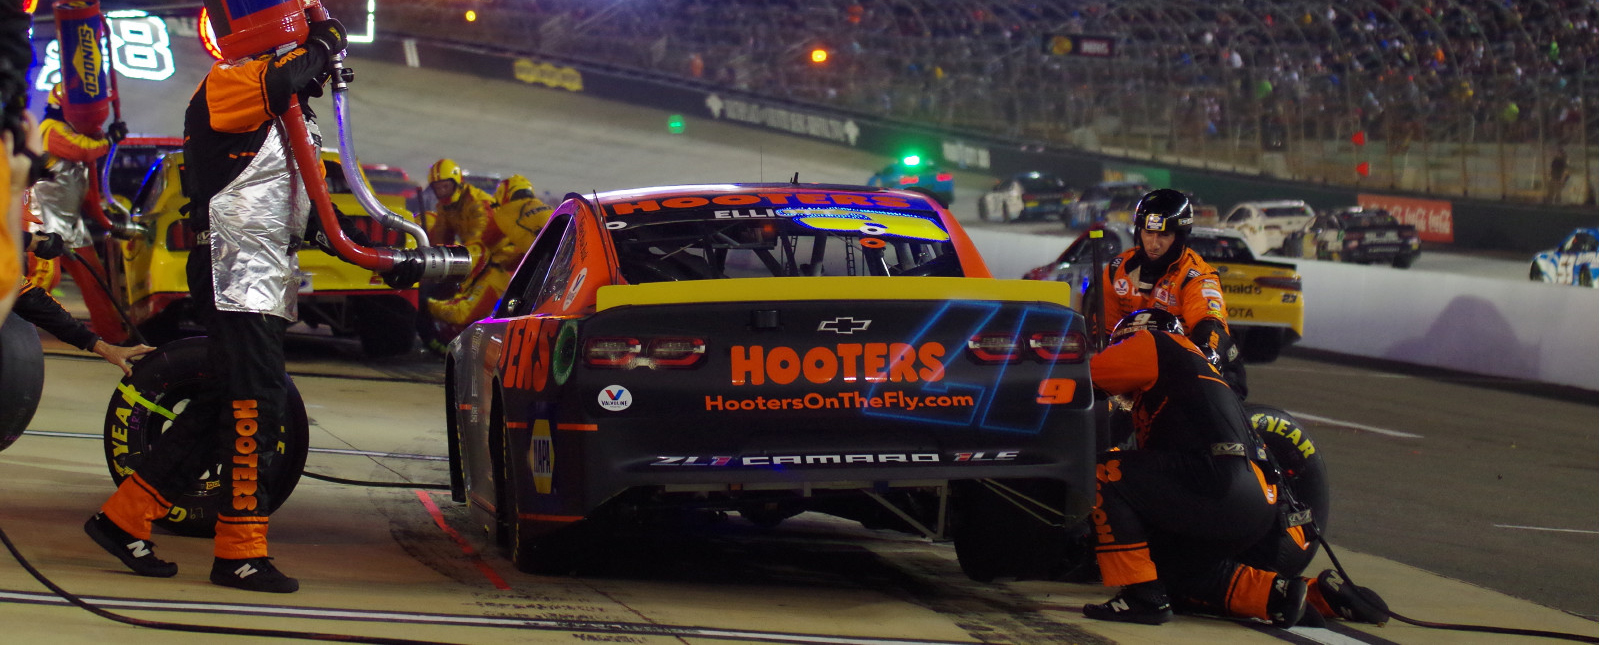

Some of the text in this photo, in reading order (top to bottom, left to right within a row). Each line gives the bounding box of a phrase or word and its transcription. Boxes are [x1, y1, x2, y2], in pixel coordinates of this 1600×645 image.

[78, 28, 99, 94] SUNOCO
[612, 193, 911, 215] HOOTERS
[731, 342, 946, 385] HOOTERS
[705, 391, 974, 411] HootersOnTheFly.com
[1036, 378, 1077, 404] 9
[1265, 415, 1316, 459] YEAR
[232, 400, 259, 511] HOOTERS
[742, 454, 940, 465] CAMARO
